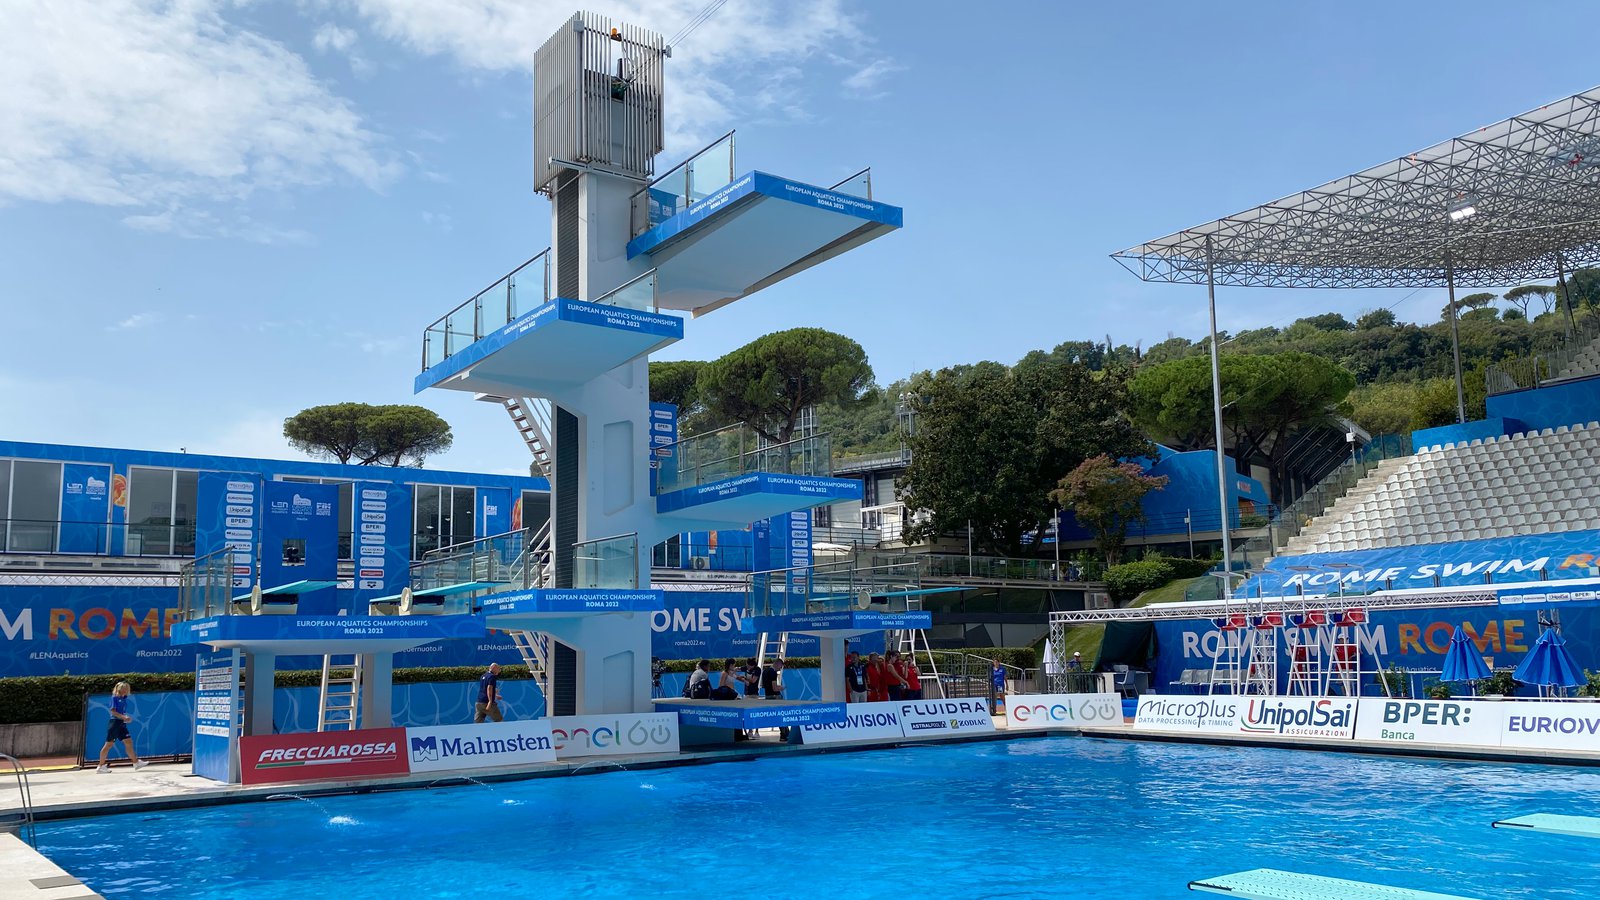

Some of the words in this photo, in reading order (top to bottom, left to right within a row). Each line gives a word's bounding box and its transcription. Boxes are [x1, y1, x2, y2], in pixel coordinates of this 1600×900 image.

[690, 200, 706, 215] EUROPEAN
[706, 192, 722, 206] AQUATICS
[722, 176, 751, 196] CHAMPIONSHIPS
[785, 184, 812, 195] EUROPEAN
[812, 190, 836, 202] AQUATICS
[836, 196, 874, 211] CHAMPIONSHIPS
[817, 199, 833, 208] ROMA
[834, 202, 844, 210] 2022
[504, 324, 516, 335] EUROPEAN
[516, 315, 531, 328] AQUATICS
[531, 304, 556, 322] CHAMPIONSHIPS
[567, 303, 600, 314] EUROPEAN
[600, 309, 629, 319] AQUATICS
[630, 314, 677, 327] CHAMPIONSHIPS
[607, 318, 626, 326] ROMA
[626, 320, 640, 328] 2022
[698, 486, 715, 494] EUROPEAN
[715, 483, 732, 491] AQUATICS
[732, 476, 759, 487] CHAMPIONSHIPS
[768, 477, 794, 485] EUROPEAN
[794, 479, 818, 487] AQUATICS
[819, 481, 857, 489] CHAMPIONSHIPS
[1282, 566, 1406, 587] ROME
[1410, 556, 1550, 580] SWIM
[484, 598, 497, 606] EUROPEAN
[509, 594, 534, 602] CHAMPIONSHIPS
[651, 608, 711, 632] OME
[1398, 620, 1528, 654] ROME
[30, 650, 88, 660] #LENAquatics
[711, 710, 739, 718] CHAMPIONSHIPS
[802, 707, 840, 715] CHAMPIONSHIPS
[902, 702, 986, 716] FLUIDRA
[1014, 699, 1075, 721] enel
[1248, 699, 1352, 733] UnipolSai
[552, 720, 621, 750] enel
[1286, 728, 1348, 736] ASSICURAZIONI
[1381, 729, 1415, 740] Banca
[258, 742, 396, 762] FRECCIAROSSA
[440, 733, 551, 758] Malmsten
